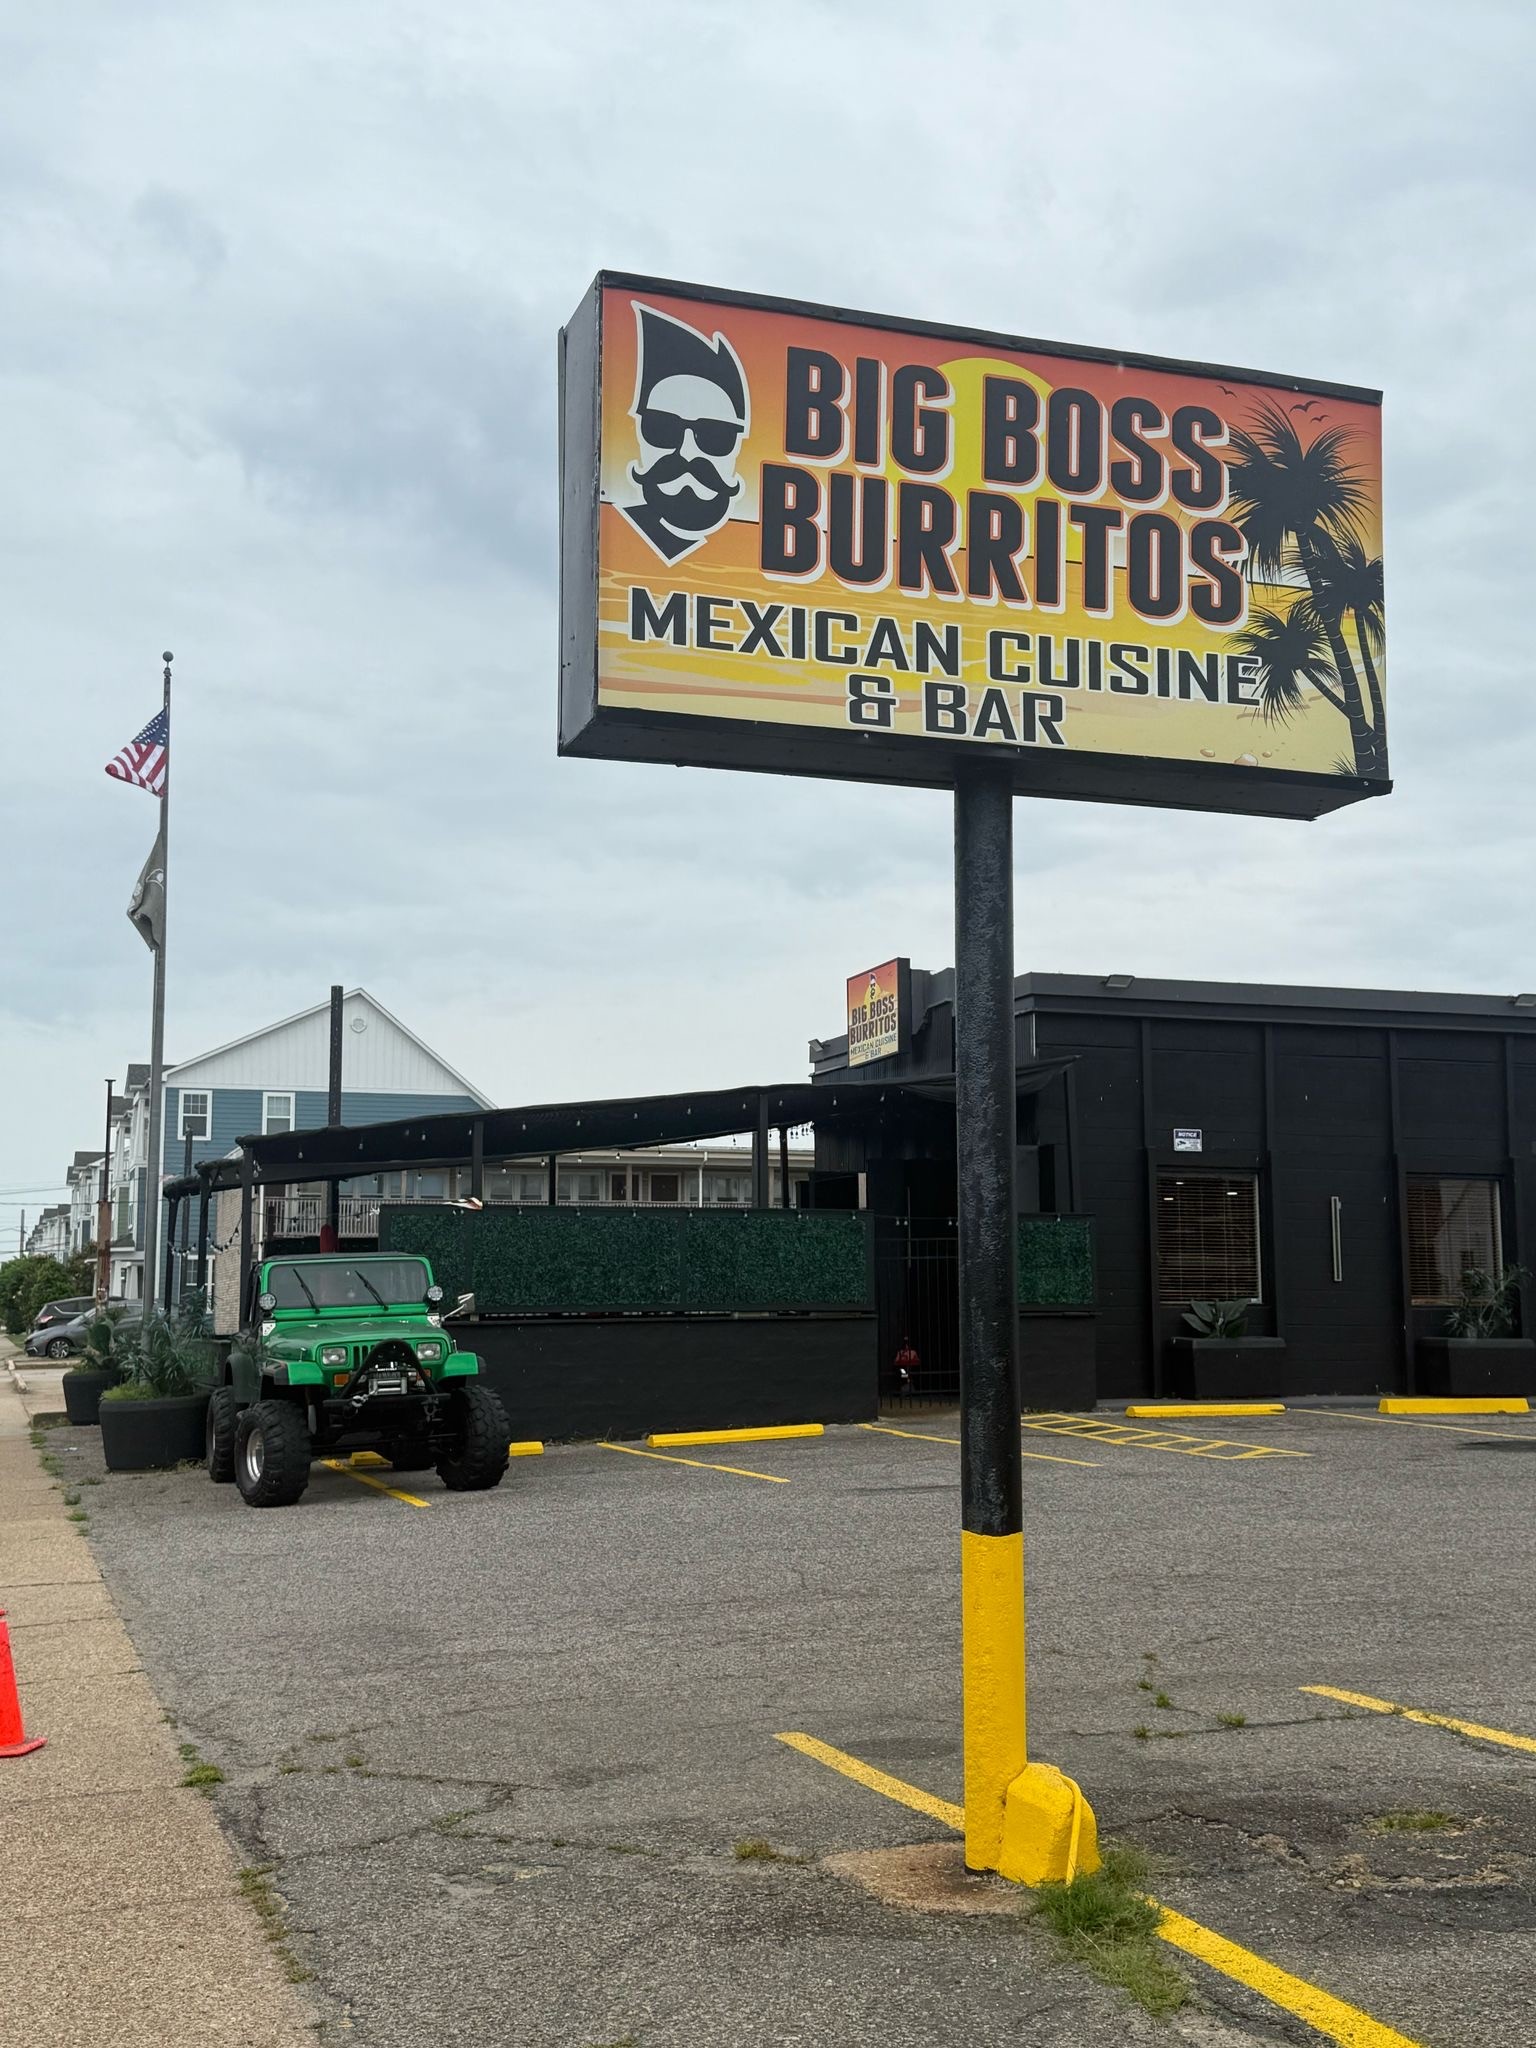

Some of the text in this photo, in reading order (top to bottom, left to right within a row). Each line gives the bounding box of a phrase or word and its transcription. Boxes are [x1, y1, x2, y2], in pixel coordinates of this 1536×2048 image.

[784, 345, 1229, 515] BIG BOSS
[760, 460, 1249, 630] BURRITOS
[627, 586, 1264, 707] MEXICAN CUISINE
[847, 673, 1067, 745] & BAR
[850, 1013, 896, 1045] BURRITOS
[852, 994, 894, 1026] BIG BOSS
[851, 1033, 896, 1055] MEXICAN CUISINE
[870, 1048, 881, 1057] BAR
